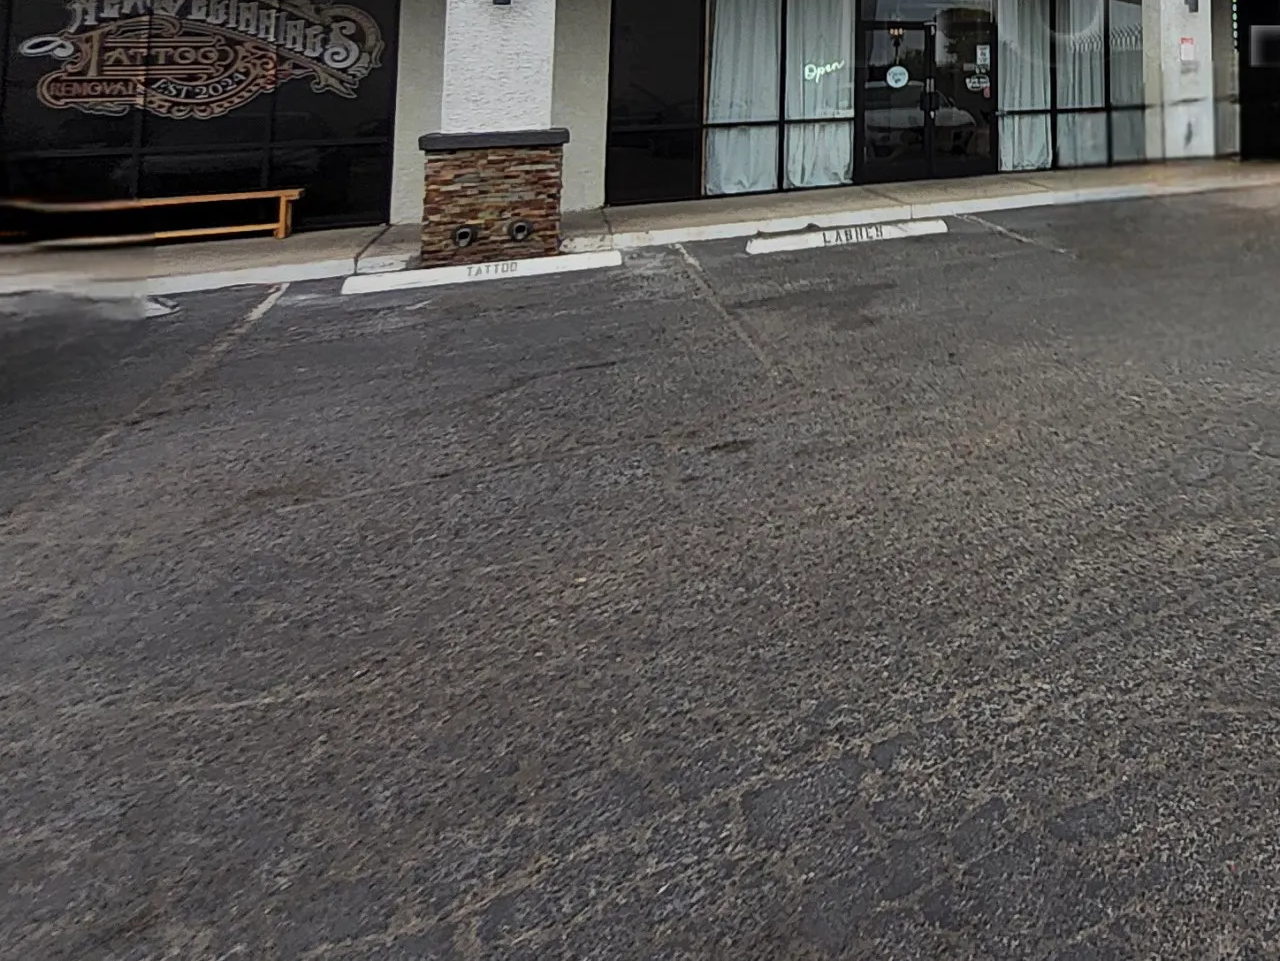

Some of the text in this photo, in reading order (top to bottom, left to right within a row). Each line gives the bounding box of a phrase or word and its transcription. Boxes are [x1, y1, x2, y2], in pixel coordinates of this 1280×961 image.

[66, 32, 220, 78] TATTOO
[804, 59, 845, 84] Open
[196, 72, 248, 100] 2024
[466, 261, 519, 277] TATTOO
